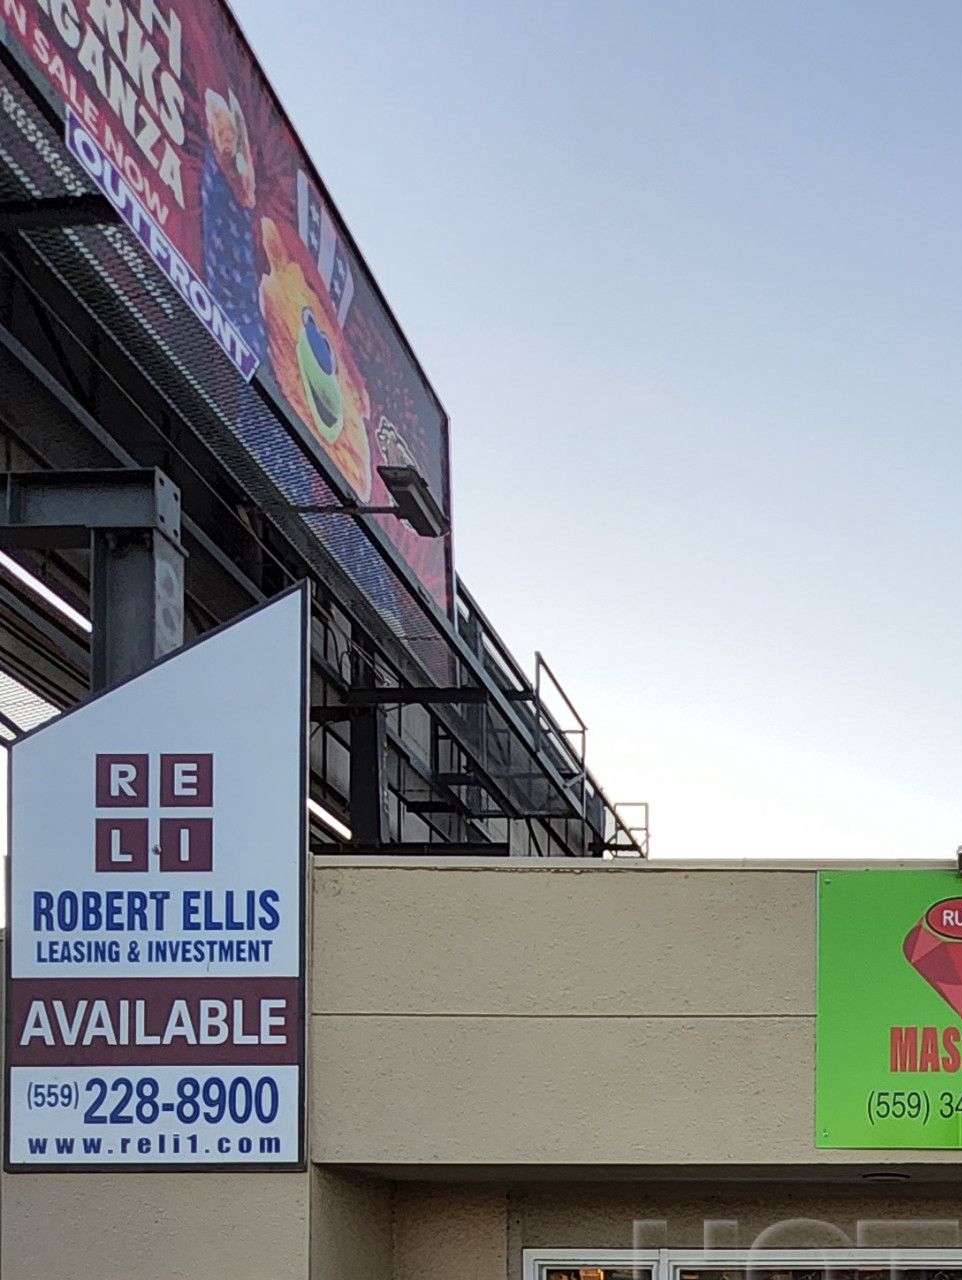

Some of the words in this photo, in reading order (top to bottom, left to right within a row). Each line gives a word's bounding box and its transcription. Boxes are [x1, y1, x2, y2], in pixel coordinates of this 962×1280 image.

[33, 26, 100, 136] SALE
[104, 123, 169, 226] NOW
[37, 0, 186, 211] GANZA
[73, 126, 250, 366] OUTFRONT
[33, 891, 170, 932] ROBERT
[182, 889, 280, 931] ELLIS
[36, 941, 121, 963] LEASING
[127, 940, 140, 963] &
[147, 940, 273, 963] INVESTMENT
[19, 999, 287, 1046] AVAILABLE
[26, 1081, 79, 1110] (559)
[83, 1076, 279, 1125] 228-8900
[867, 1089, 931, 1125] (559)
[28, 1133, 281, 1154] www.reli1.com
